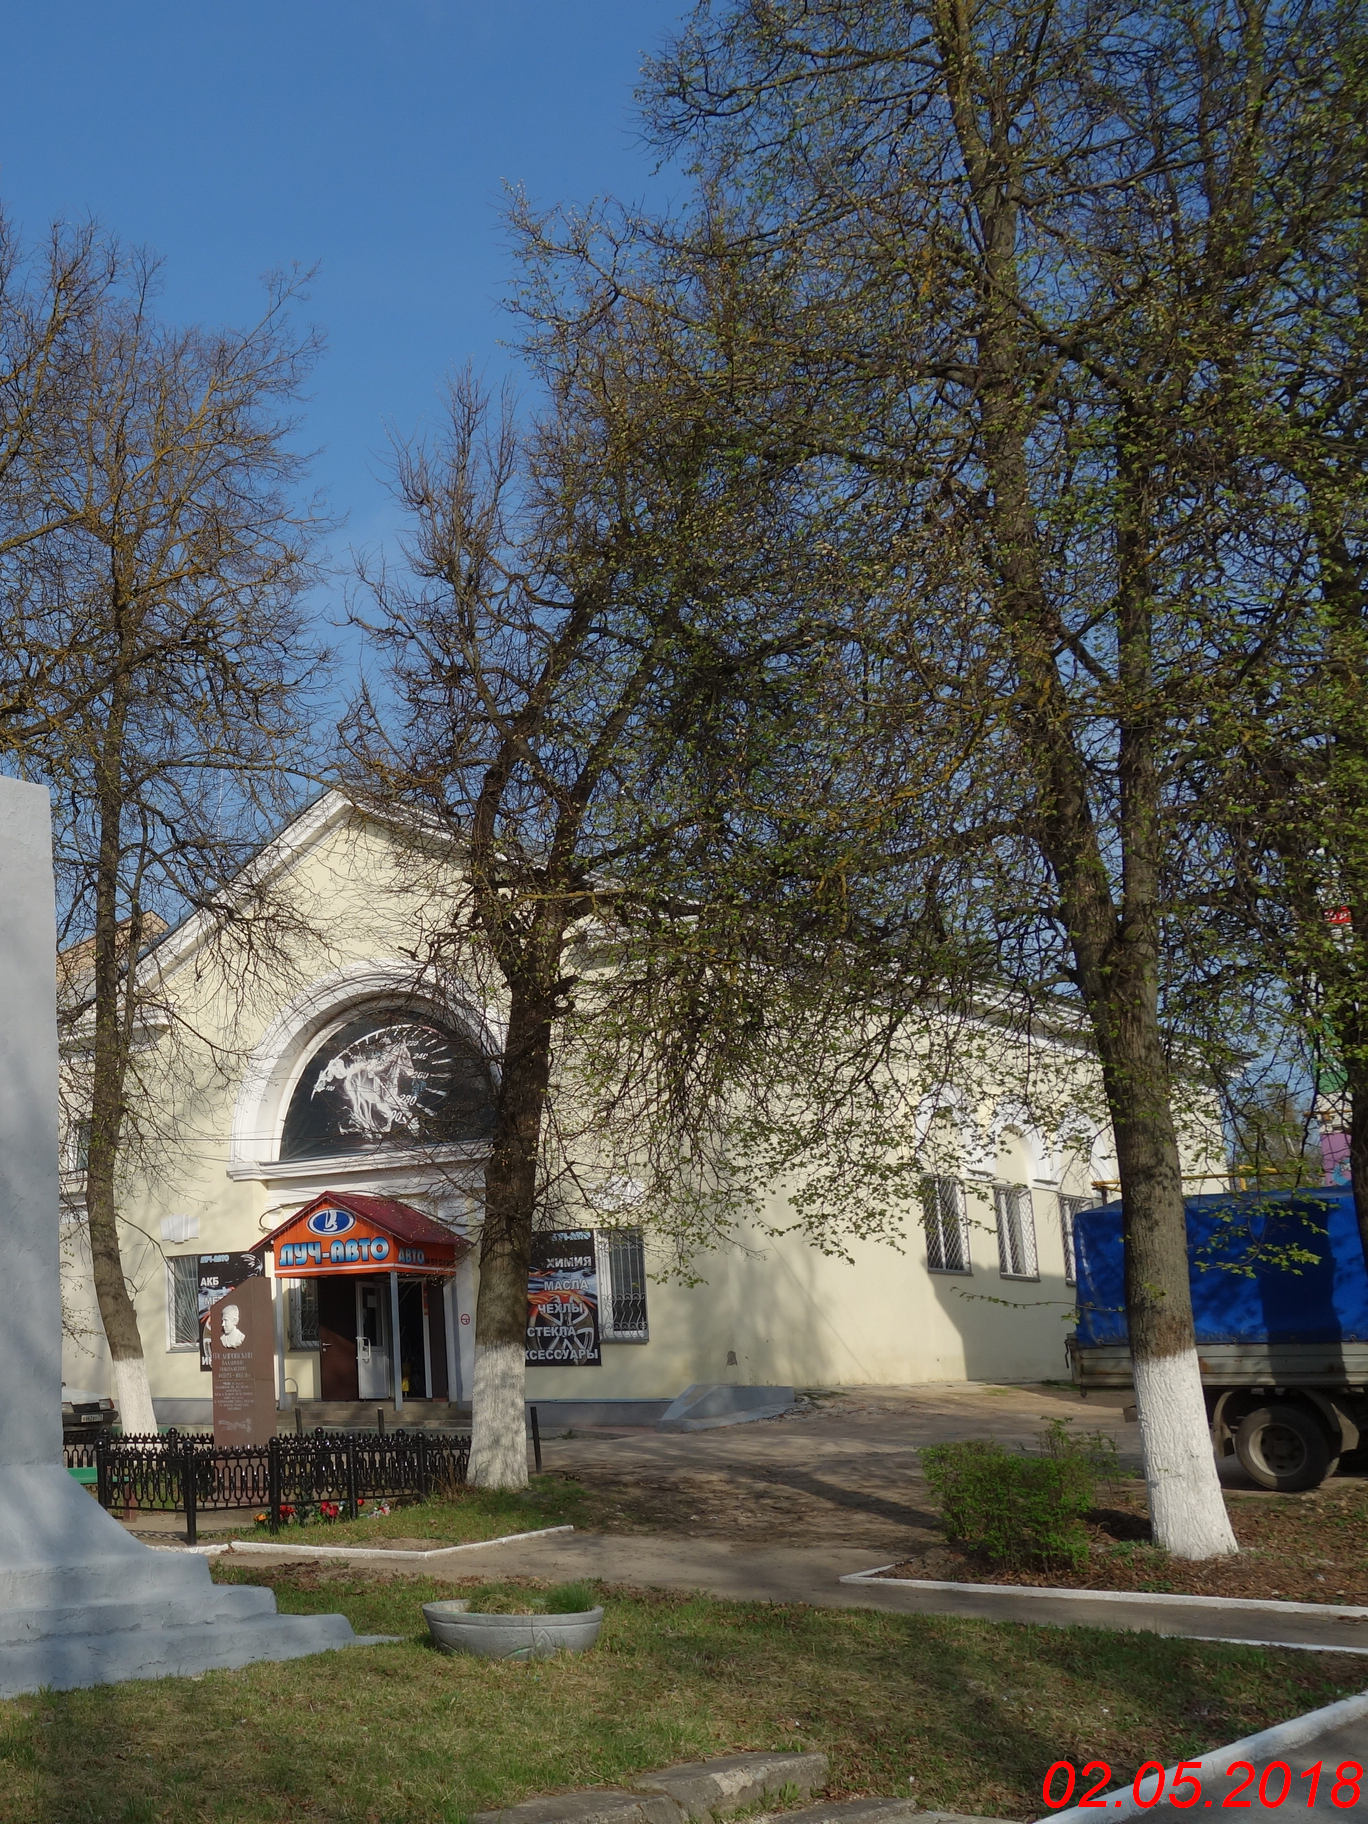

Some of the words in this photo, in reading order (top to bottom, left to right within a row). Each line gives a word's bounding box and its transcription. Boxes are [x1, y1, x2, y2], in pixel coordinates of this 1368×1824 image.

[279, 1236, 390, 1267] ЛУЧ-АВТО
[398, 1247, 425, 1264] АВТО
[546, 1256, 592, 1268] ХИМИЯ
[200, 1276, 220, 1287] АКБ
[543, 1280, 589, 1291] МАСЛА
[537, 1302, 584, 1314] ЧЕХЛЫ
[527, 1326, 577, 1338] СТЕКЛА
[525, 1348, 599, 1361] КСЕССУАРЫ
